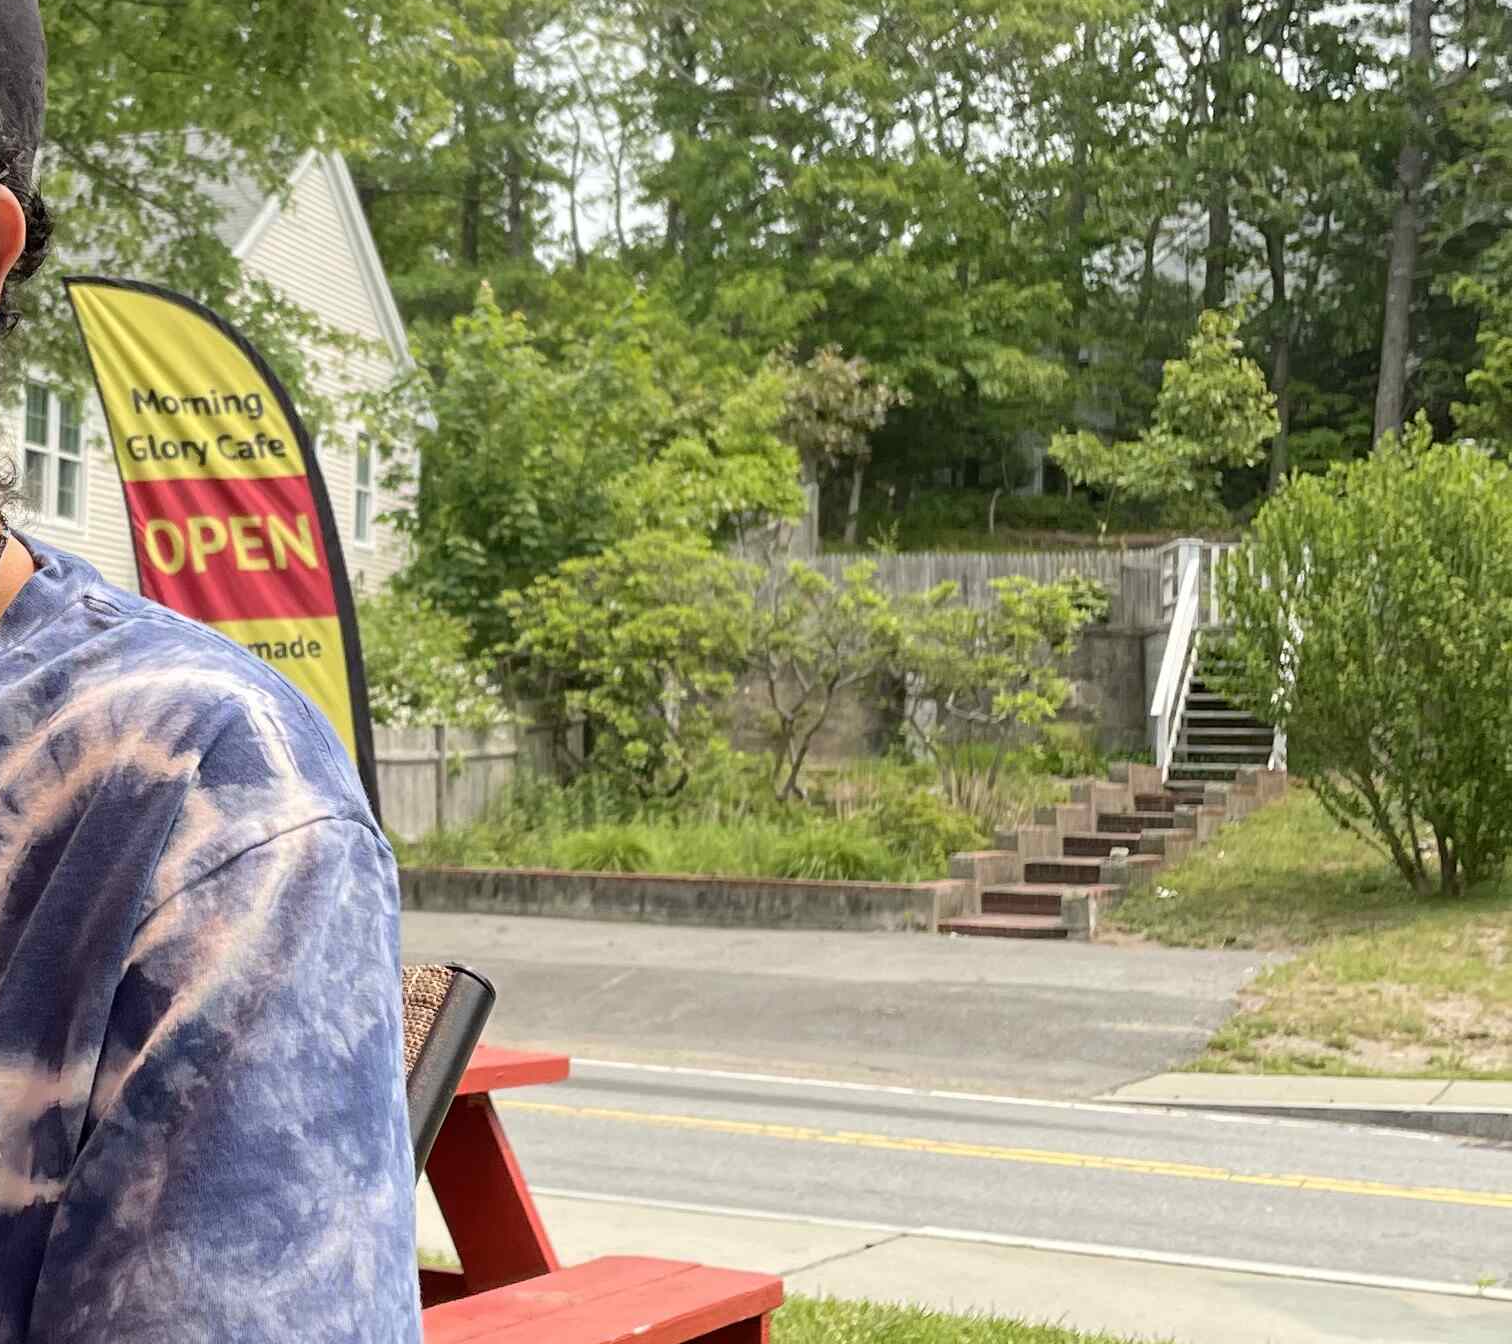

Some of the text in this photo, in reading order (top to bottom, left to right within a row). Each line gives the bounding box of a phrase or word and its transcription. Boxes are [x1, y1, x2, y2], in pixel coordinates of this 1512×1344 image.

[132, 388, 264, 420] Morning
[126, 433, 287, 466] Glory Cafe
[145, 513, 320, 576] OPEN
